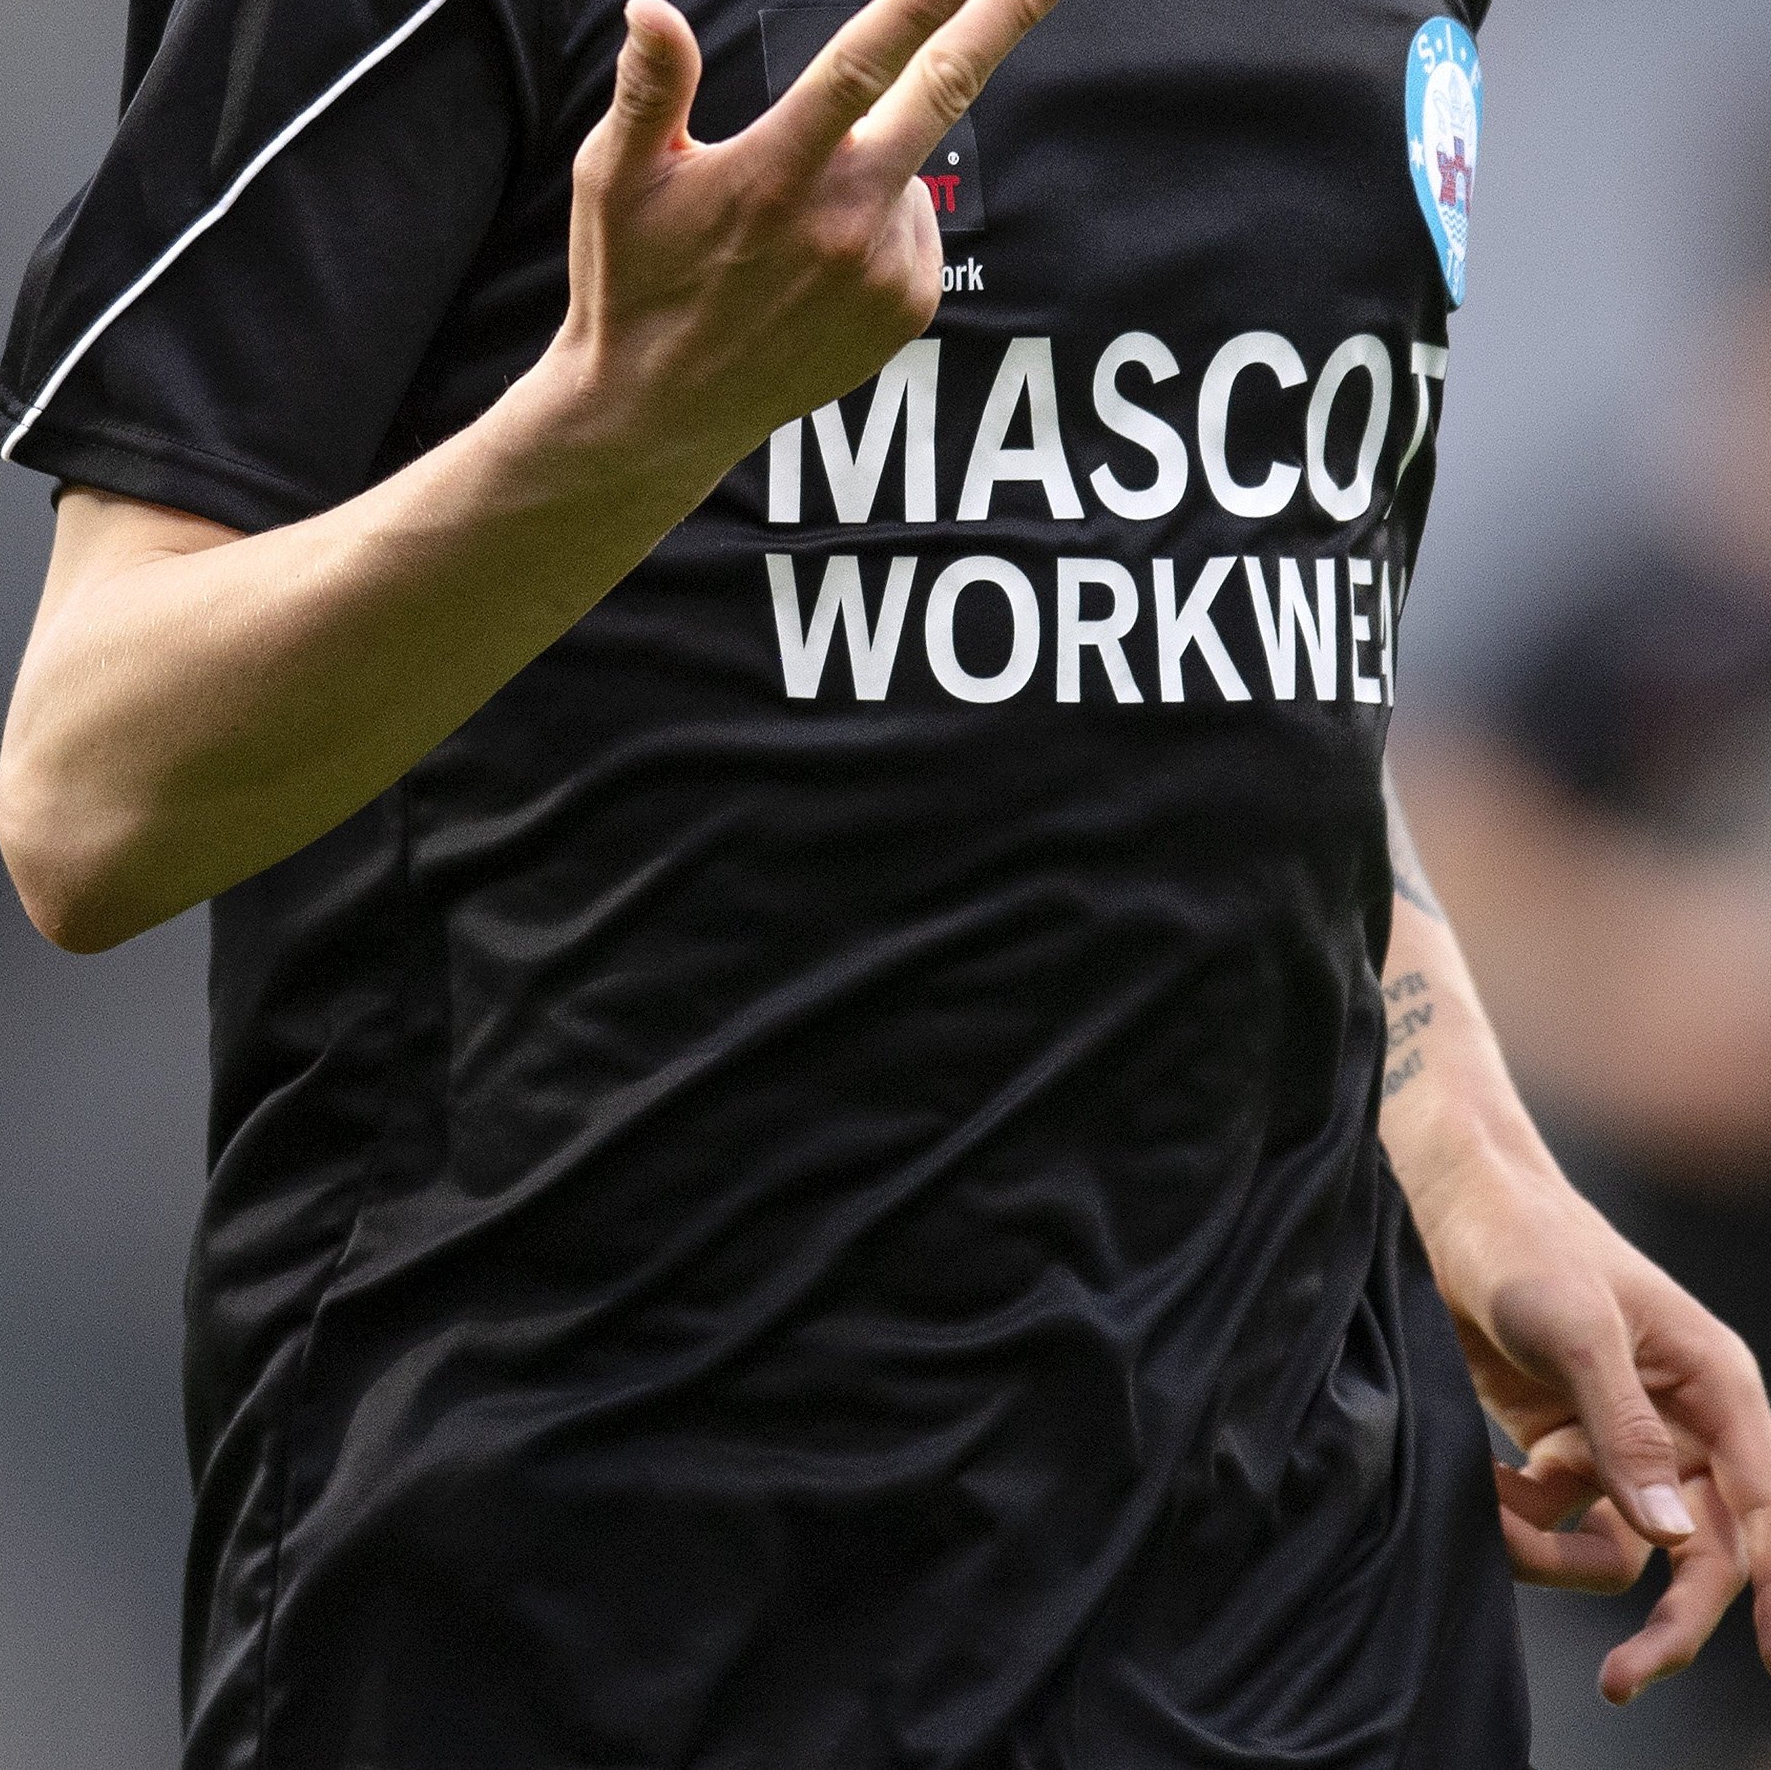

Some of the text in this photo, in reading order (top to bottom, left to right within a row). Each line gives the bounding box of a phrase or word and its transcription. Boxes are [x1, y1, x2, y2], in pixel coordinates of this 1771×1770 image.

[940, 256, 985, 293] ork
[767, 331, 1450, 525] MASCOT
[764, 552, 1406, 708] WORKWEA
